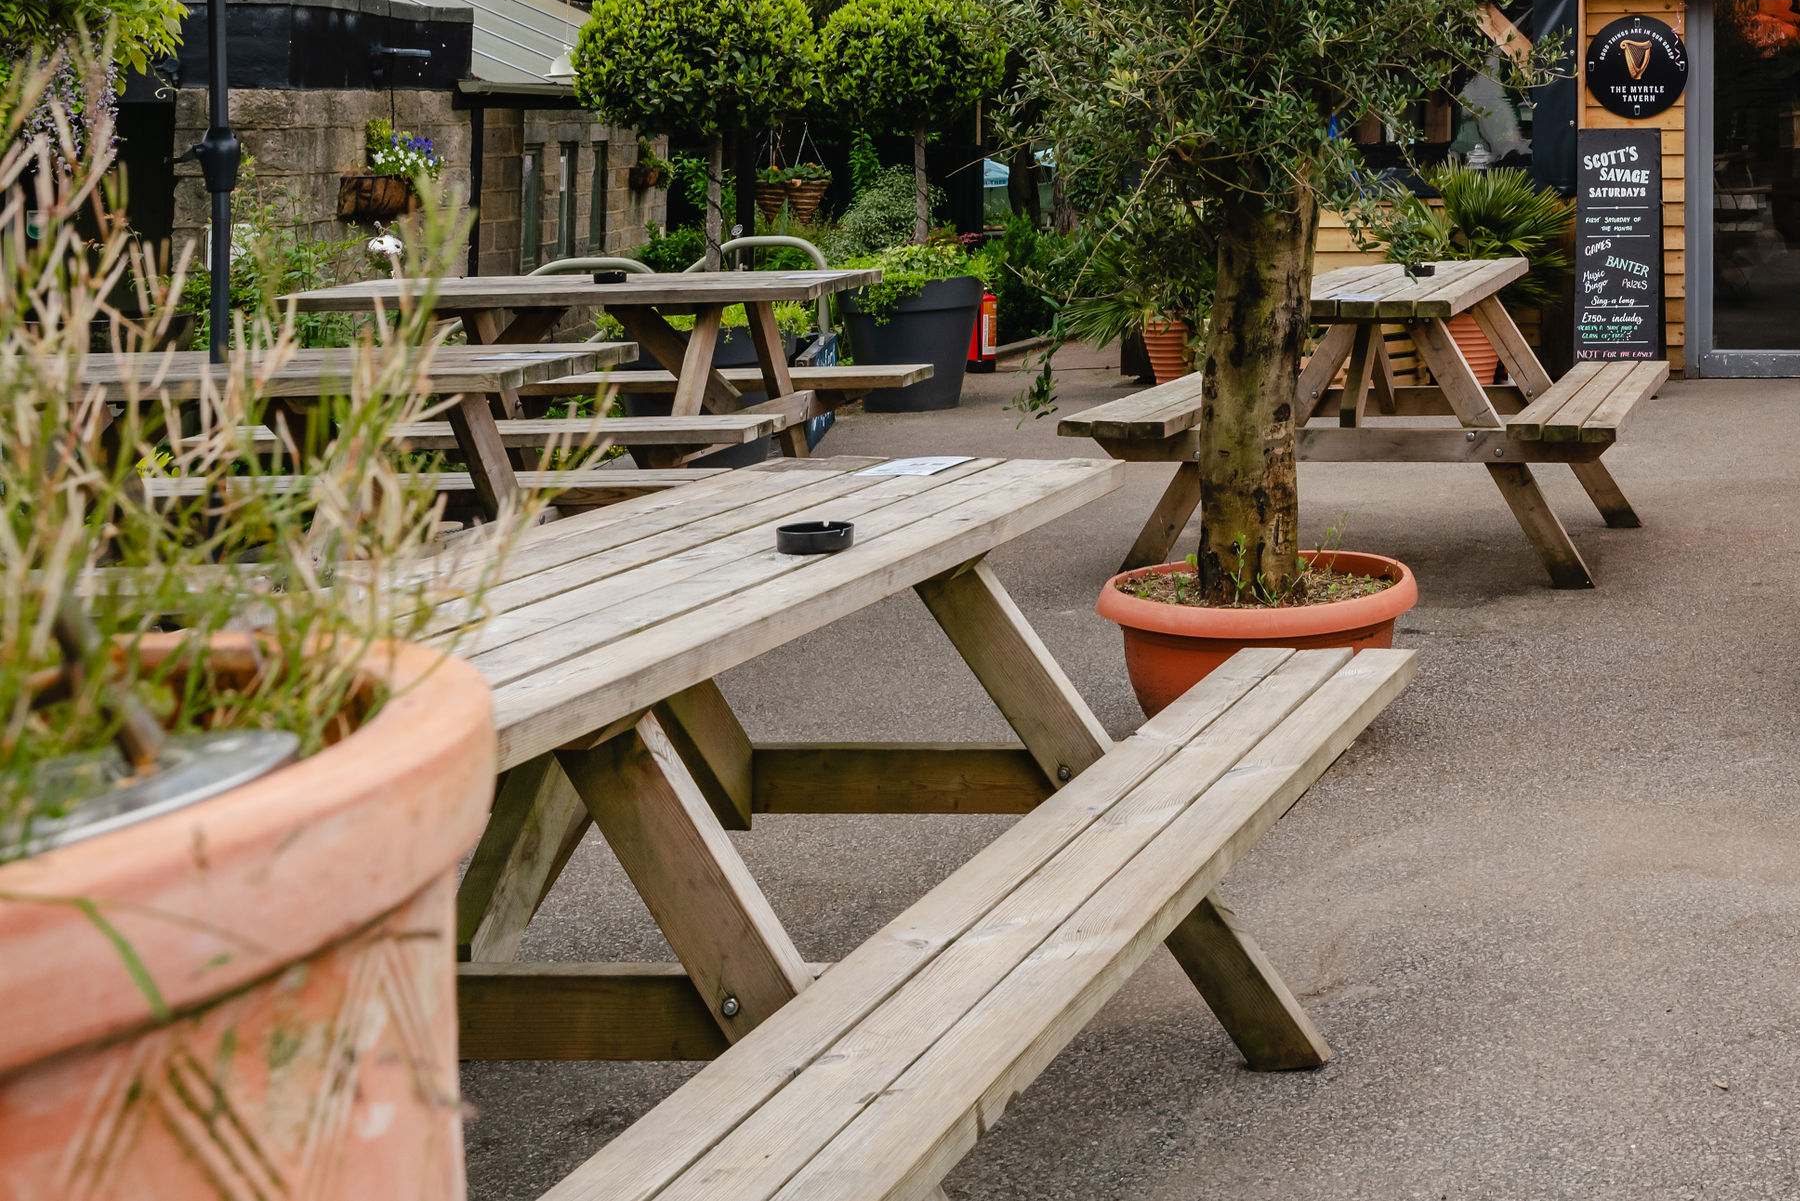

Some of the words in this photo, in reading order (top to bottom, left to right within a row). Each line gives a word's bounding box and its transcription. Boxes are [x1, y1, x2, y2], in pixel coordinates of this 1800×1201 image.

[1599, 44, 1610, 60] GOOD
[1608, 29, 1629, 45] THINGS
[1651, 32, 1663, 42] OUR
[1662, 41, 1674, 60] GRASP
[1583, 146, 1639, 170] SCOTT'S
[1599, 167, 1650, 184] SAVAGE
[1588, 187, 1646, 198] SATURDAYS
[1584, 238, 1612, 256] GAMES
[1605, 255, 1650, 278] BANTER
[1582, 269, 1606, 283] Music
[1584, 279, 1609, 294] Bingo
[1621, 278, 1648, 290] PRIZES
[1611, 312, 1643, 325] includes
[1576, 350, 1600, 359] NOT
[1602, 349, 1617, 358] FOR
[1632, 350, 1654, 358] EASILY
